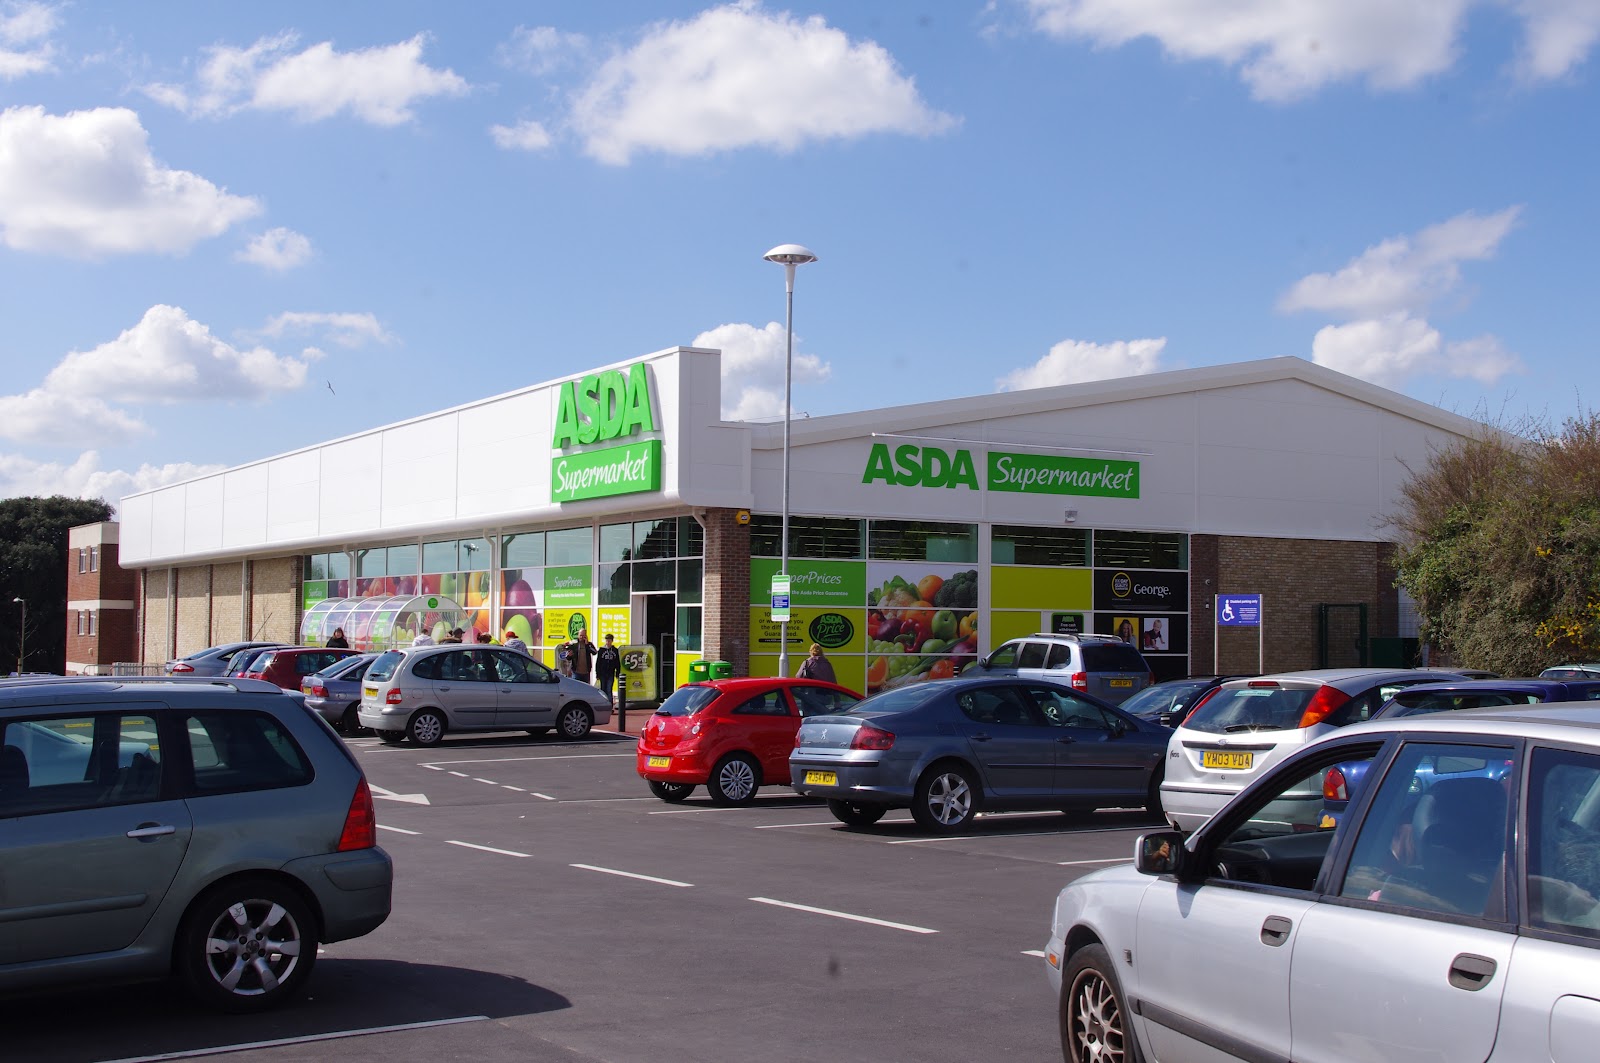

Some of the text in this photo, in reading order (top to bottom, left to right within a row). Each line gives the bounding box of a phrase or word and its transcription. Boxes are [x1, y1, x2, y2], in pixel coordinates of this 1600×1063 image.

[552, 362, 654, 450] ASDA
[554, 449, 648, 498] Supermarket
[862, 443, 980, 490] ASDA
[993, 456, 1134, 491] Supermarket
[820, 615, 843, 624] ASDA
